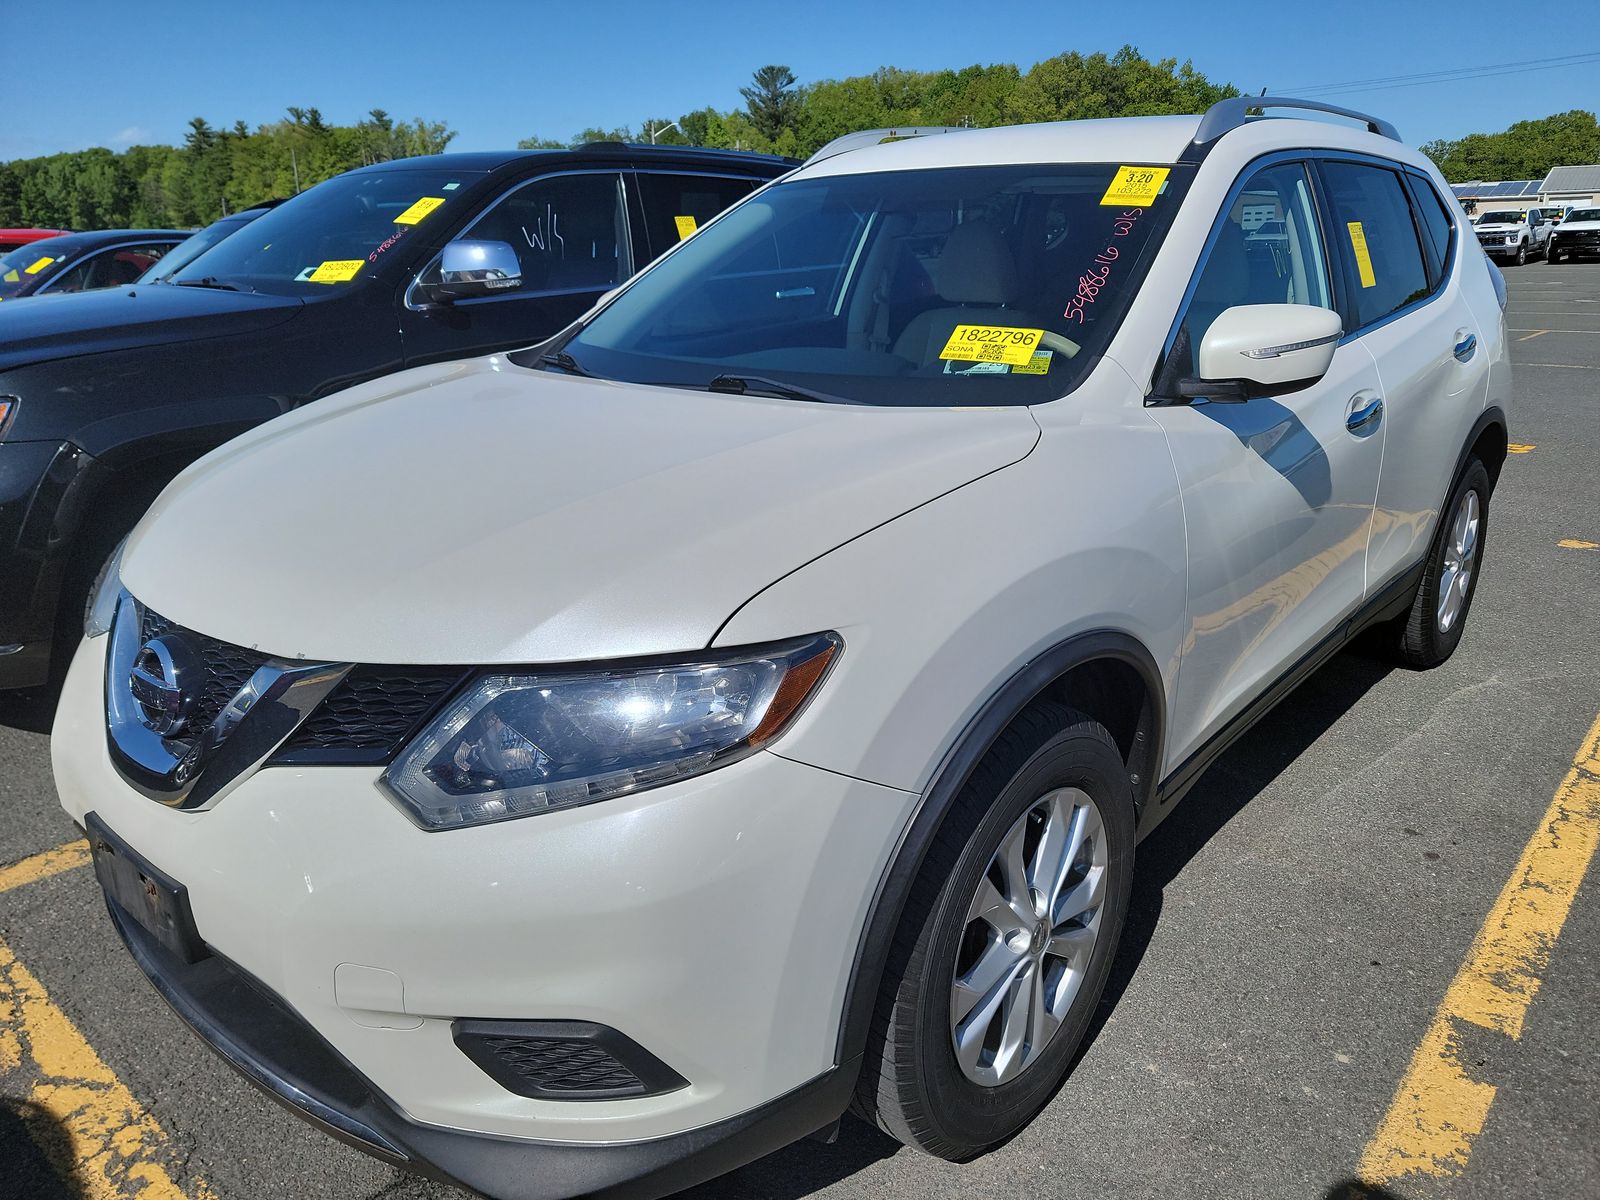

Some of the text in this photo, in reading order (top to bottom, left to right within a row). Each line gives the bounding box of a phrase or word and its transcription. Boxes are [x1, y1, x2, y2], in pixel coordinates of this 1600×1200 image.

[1126, 173, 1154, 183] 3:20
[959, 328, 1036, 346] 1822796
[946, 345, 975, 353] SONA
